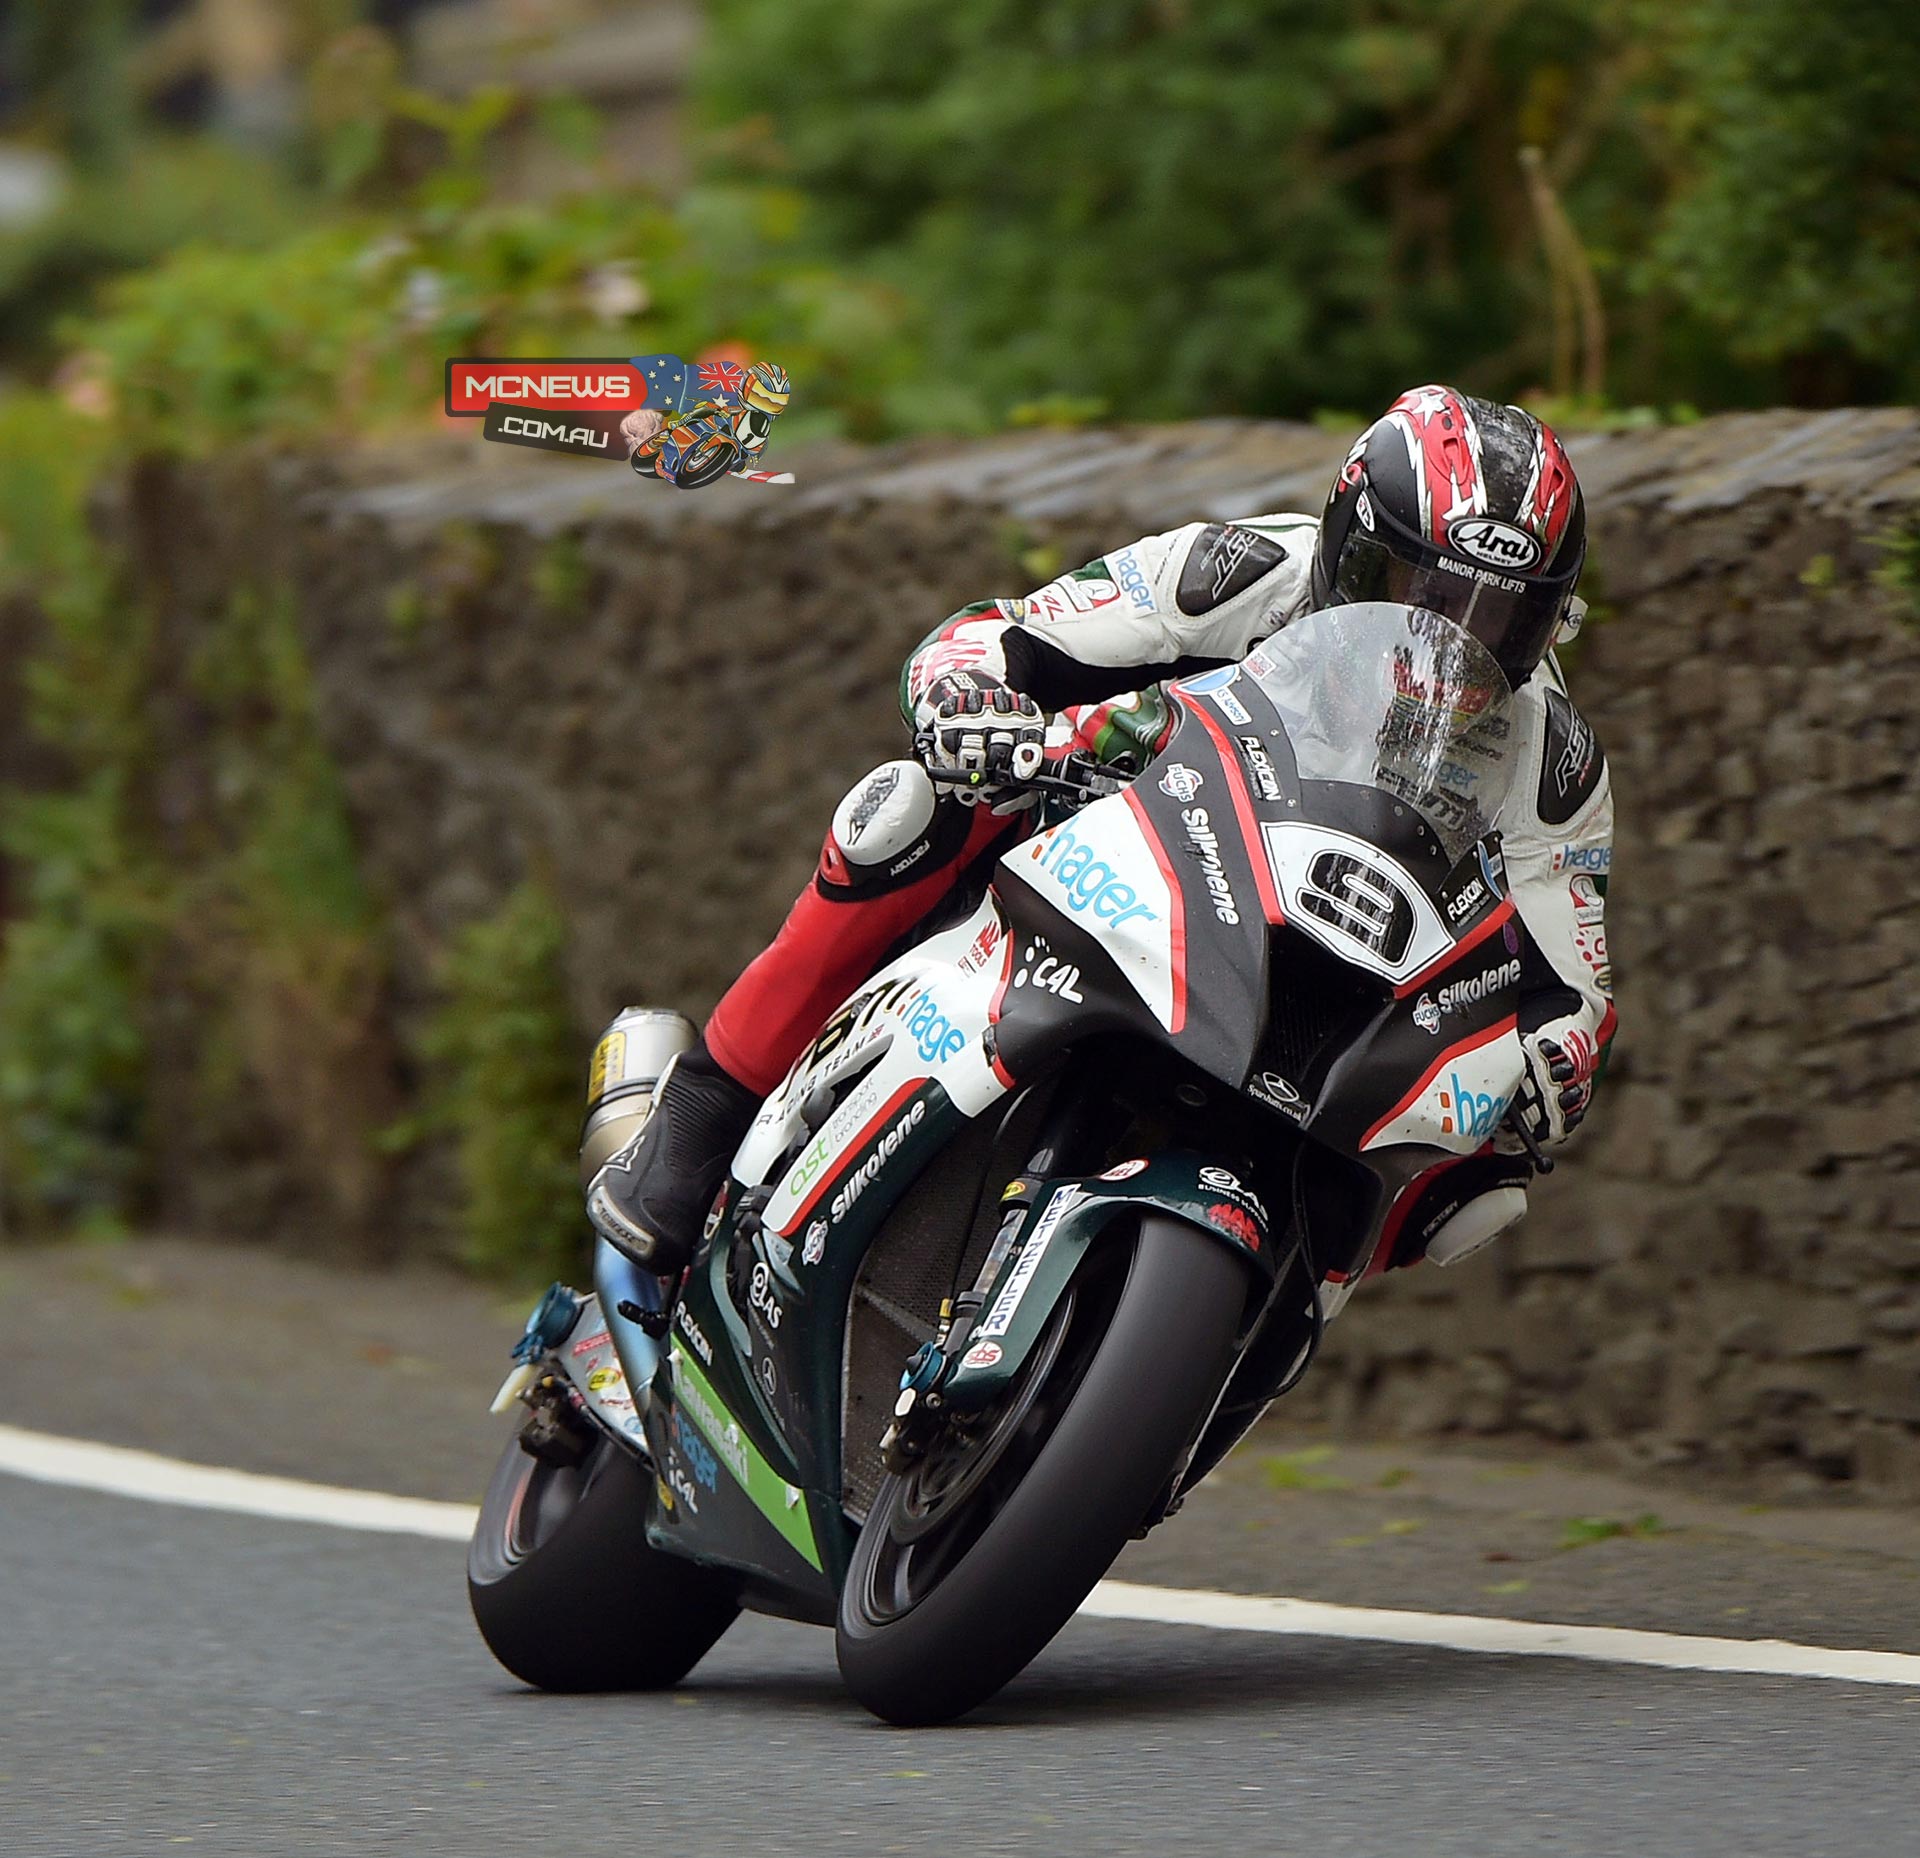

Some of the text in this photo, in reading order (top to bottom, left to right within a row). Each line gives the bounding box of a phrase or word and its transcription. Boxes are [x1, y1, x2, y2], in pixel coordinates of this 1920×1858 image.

[1455, 525, 1533, 561] Arai
[1437, 556, 1527, 594] MANOR PARK LIFTS
[1170, 765, 1194, 801] FUCHS
[889, 839, 931, 878] FACTORY
[1041, 816, 1158, 930] hager
[1414, 1004, 1440, 1024] FUCHS
[824, 1036, 866, 1077] TEAM
[1198, 1183, 1240, 1202] BUSINESS
[985, 1187, 1076, 1331] METZELER
